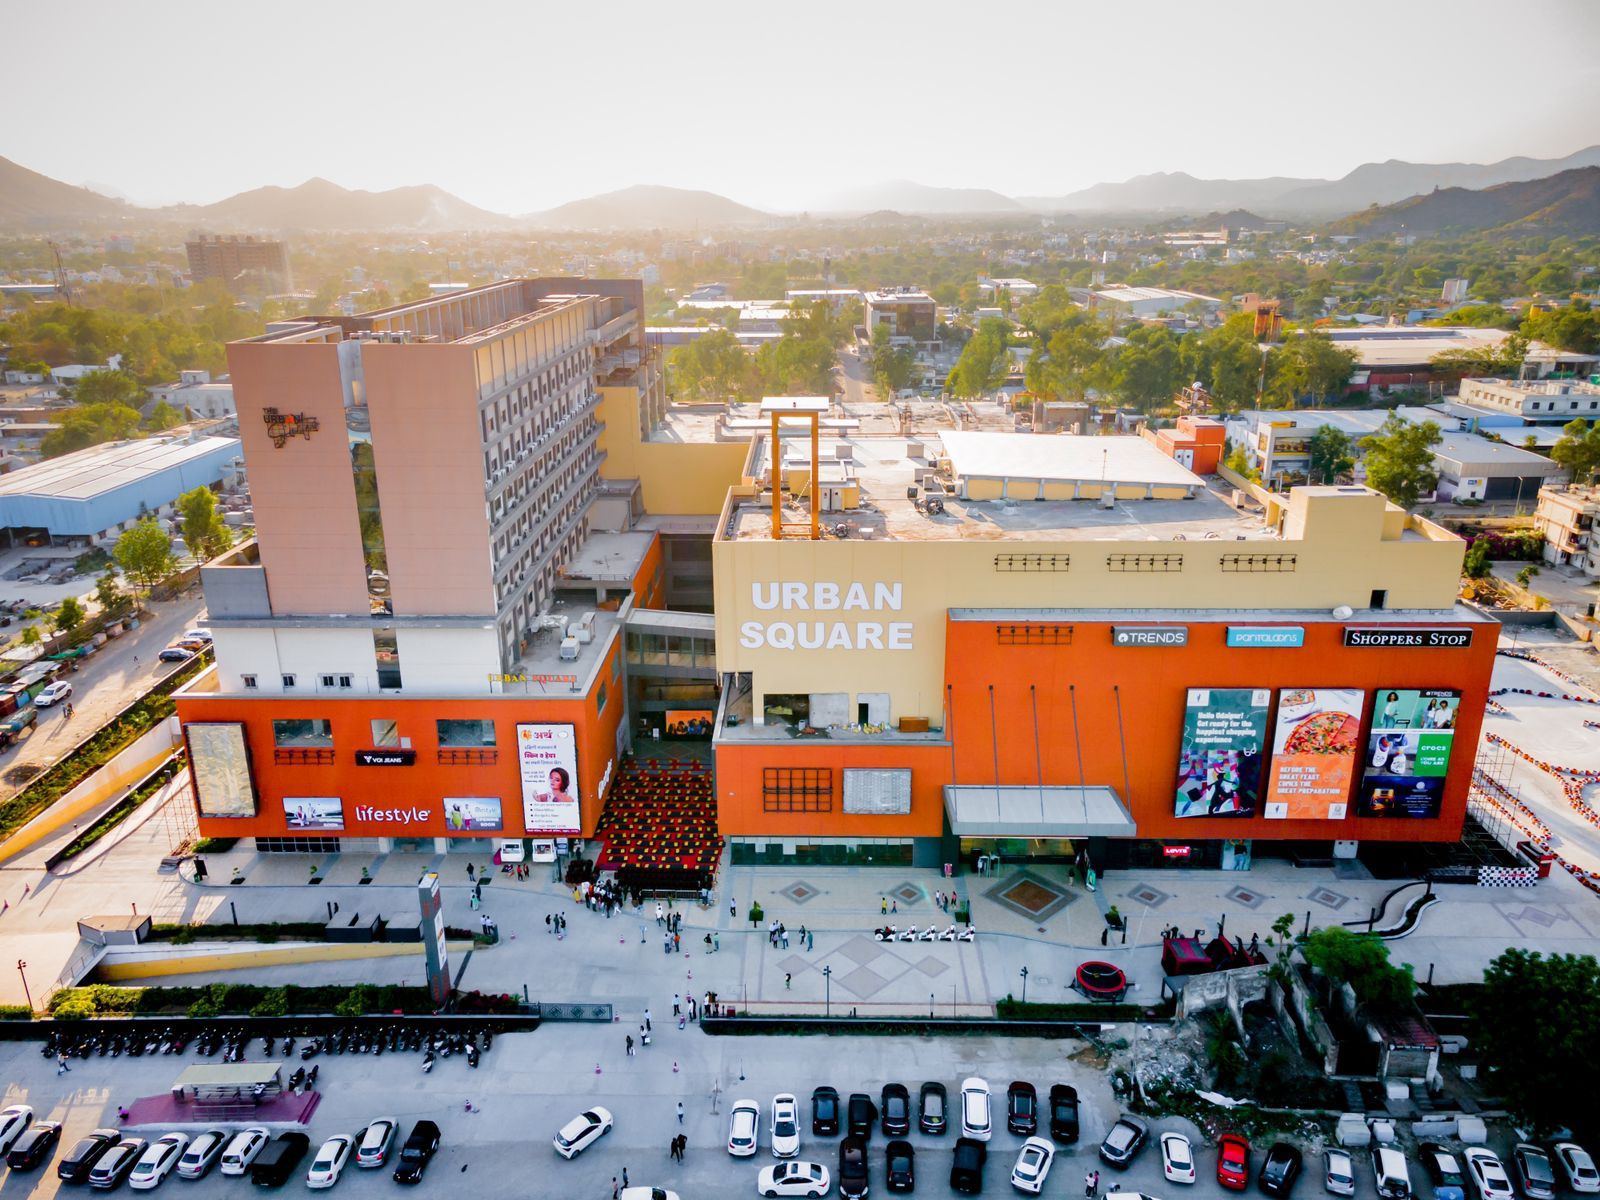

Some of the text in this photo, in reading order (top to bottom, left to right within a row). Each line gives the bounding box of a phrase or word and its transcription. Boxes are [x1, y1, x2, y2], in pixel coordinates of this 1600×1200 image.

[751, 582, 903, 611] URBAN
[739, 621, 914, 651] SQUARE
[1129, 632, 1185, 643] TRENDS
[1216, 712, 1244, 720] Udaipur!
[1209, 720, 1229, 728] ready
[1195, 728, 1257, 737] happiest shopping
[1194, 736, 1233, 744] experience
[355, 804, 429, 825] lifestyle
